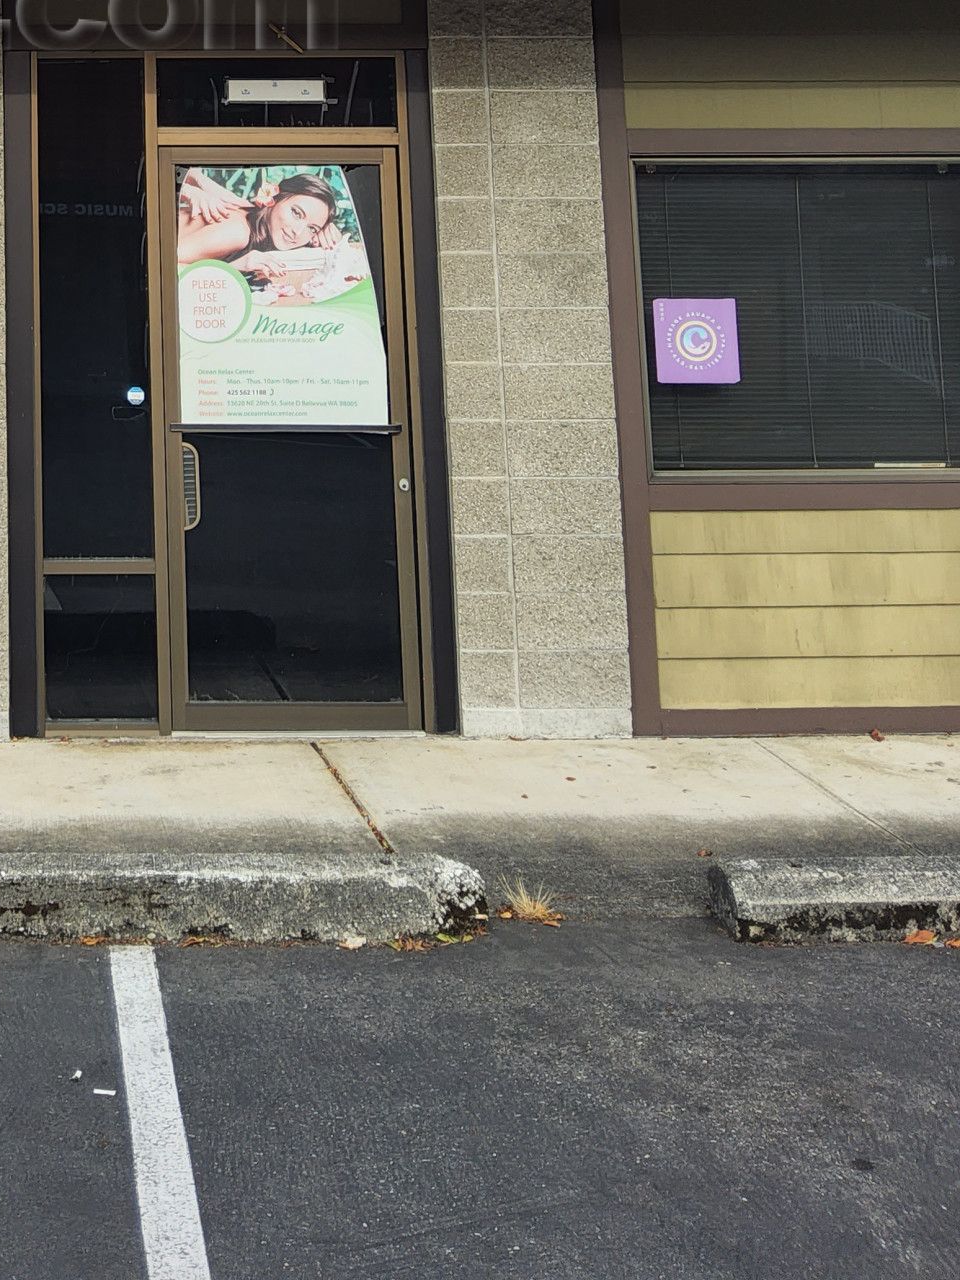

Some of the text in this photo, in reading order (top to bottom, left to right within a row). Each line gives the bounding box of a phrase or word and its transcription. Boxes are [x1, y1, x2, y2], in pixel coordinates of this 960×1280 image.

[192, 279, 228, 289] PLEASE
[199, 292, 218, 302] USE
[193, 306, 228, 316] FRONT
[195, 319, 227, 329] DOOR
[252, 314, 345, 342] Massage
